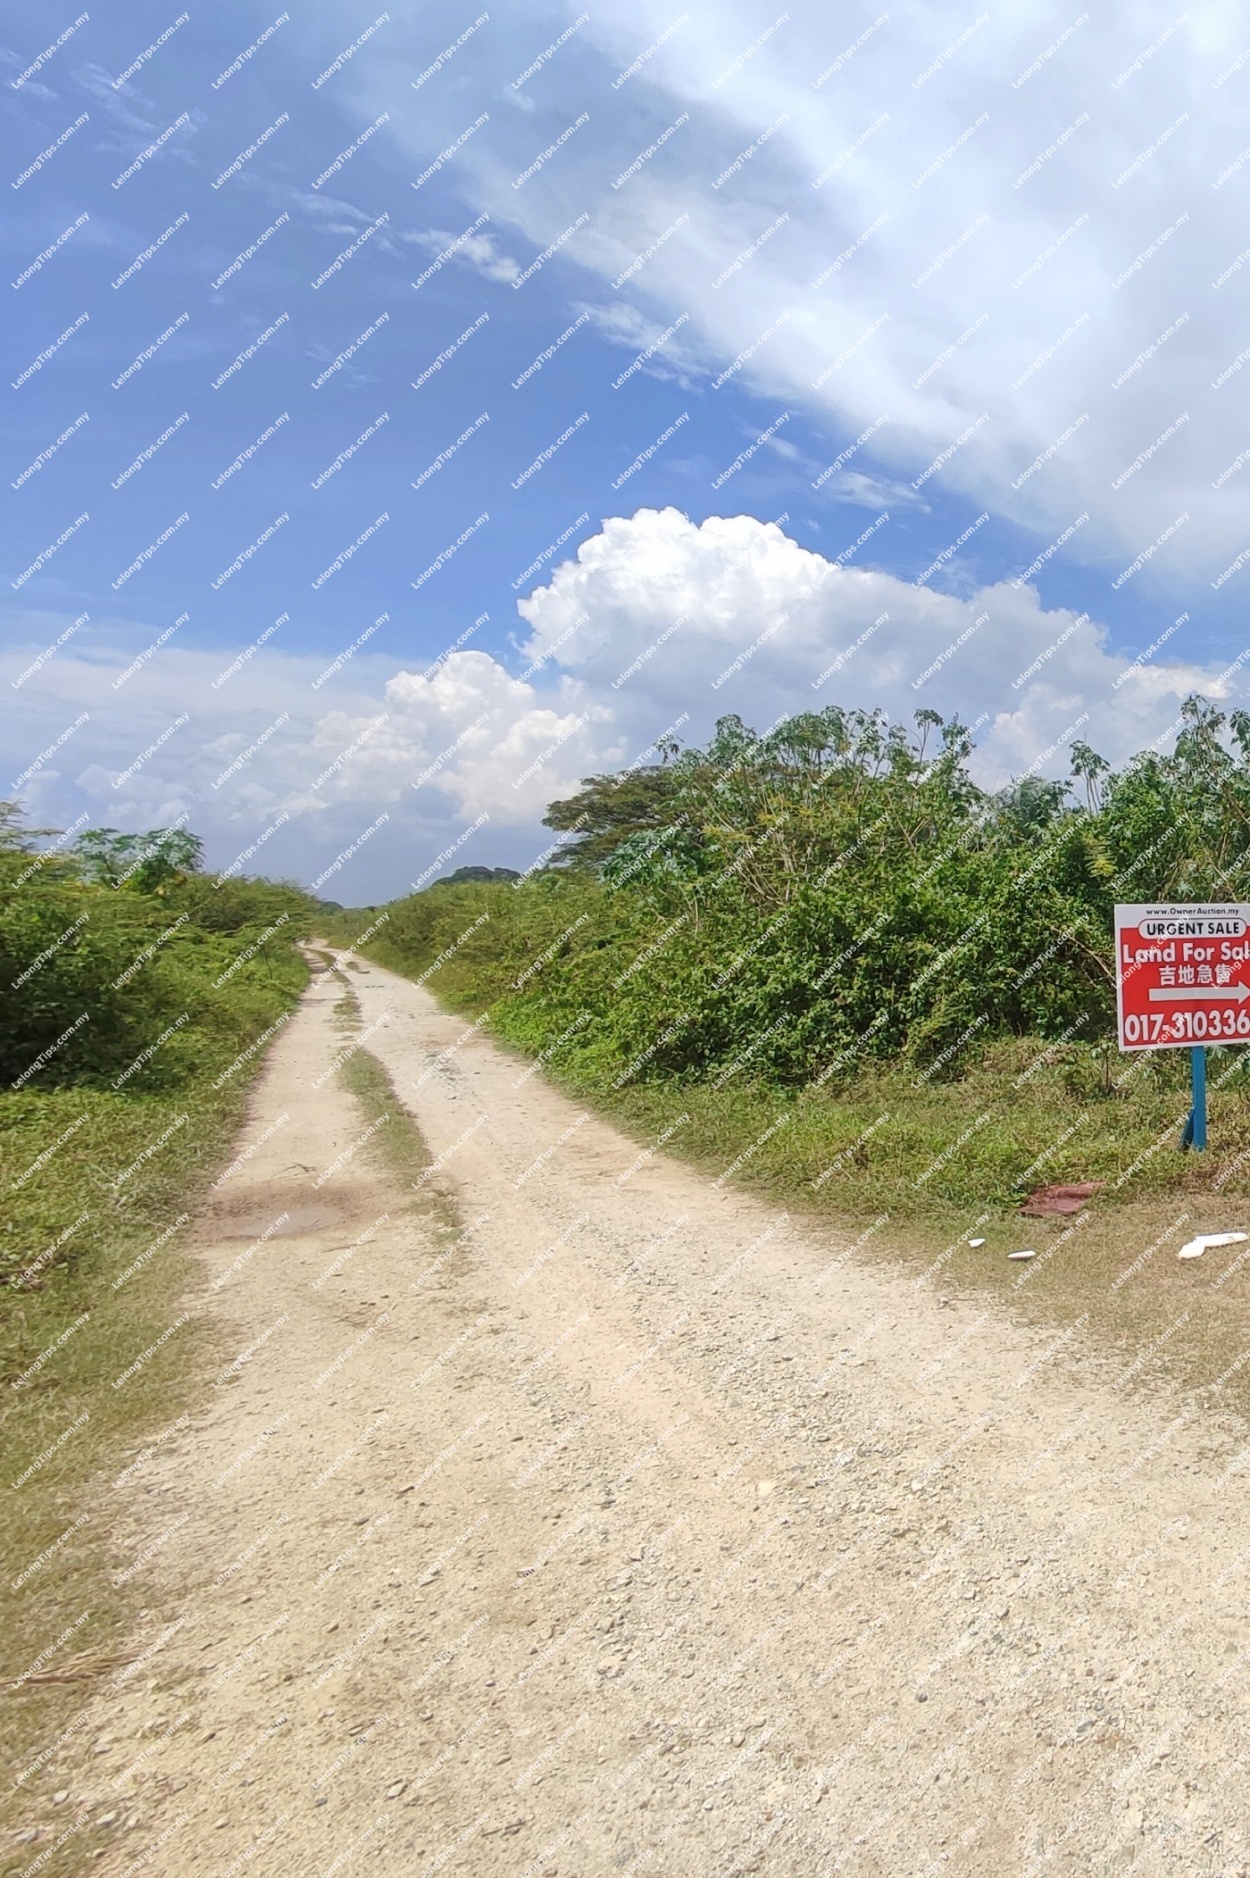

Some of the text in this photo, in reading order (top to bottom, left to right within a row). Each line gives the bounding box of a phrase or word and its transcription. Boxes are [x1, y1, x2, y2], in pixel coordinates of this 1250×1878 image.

[1147, 922, 1239, 936] URGENT SALE
[1123, 942, 1176, 964] Land
[1182, 942, 1215, 962] For
